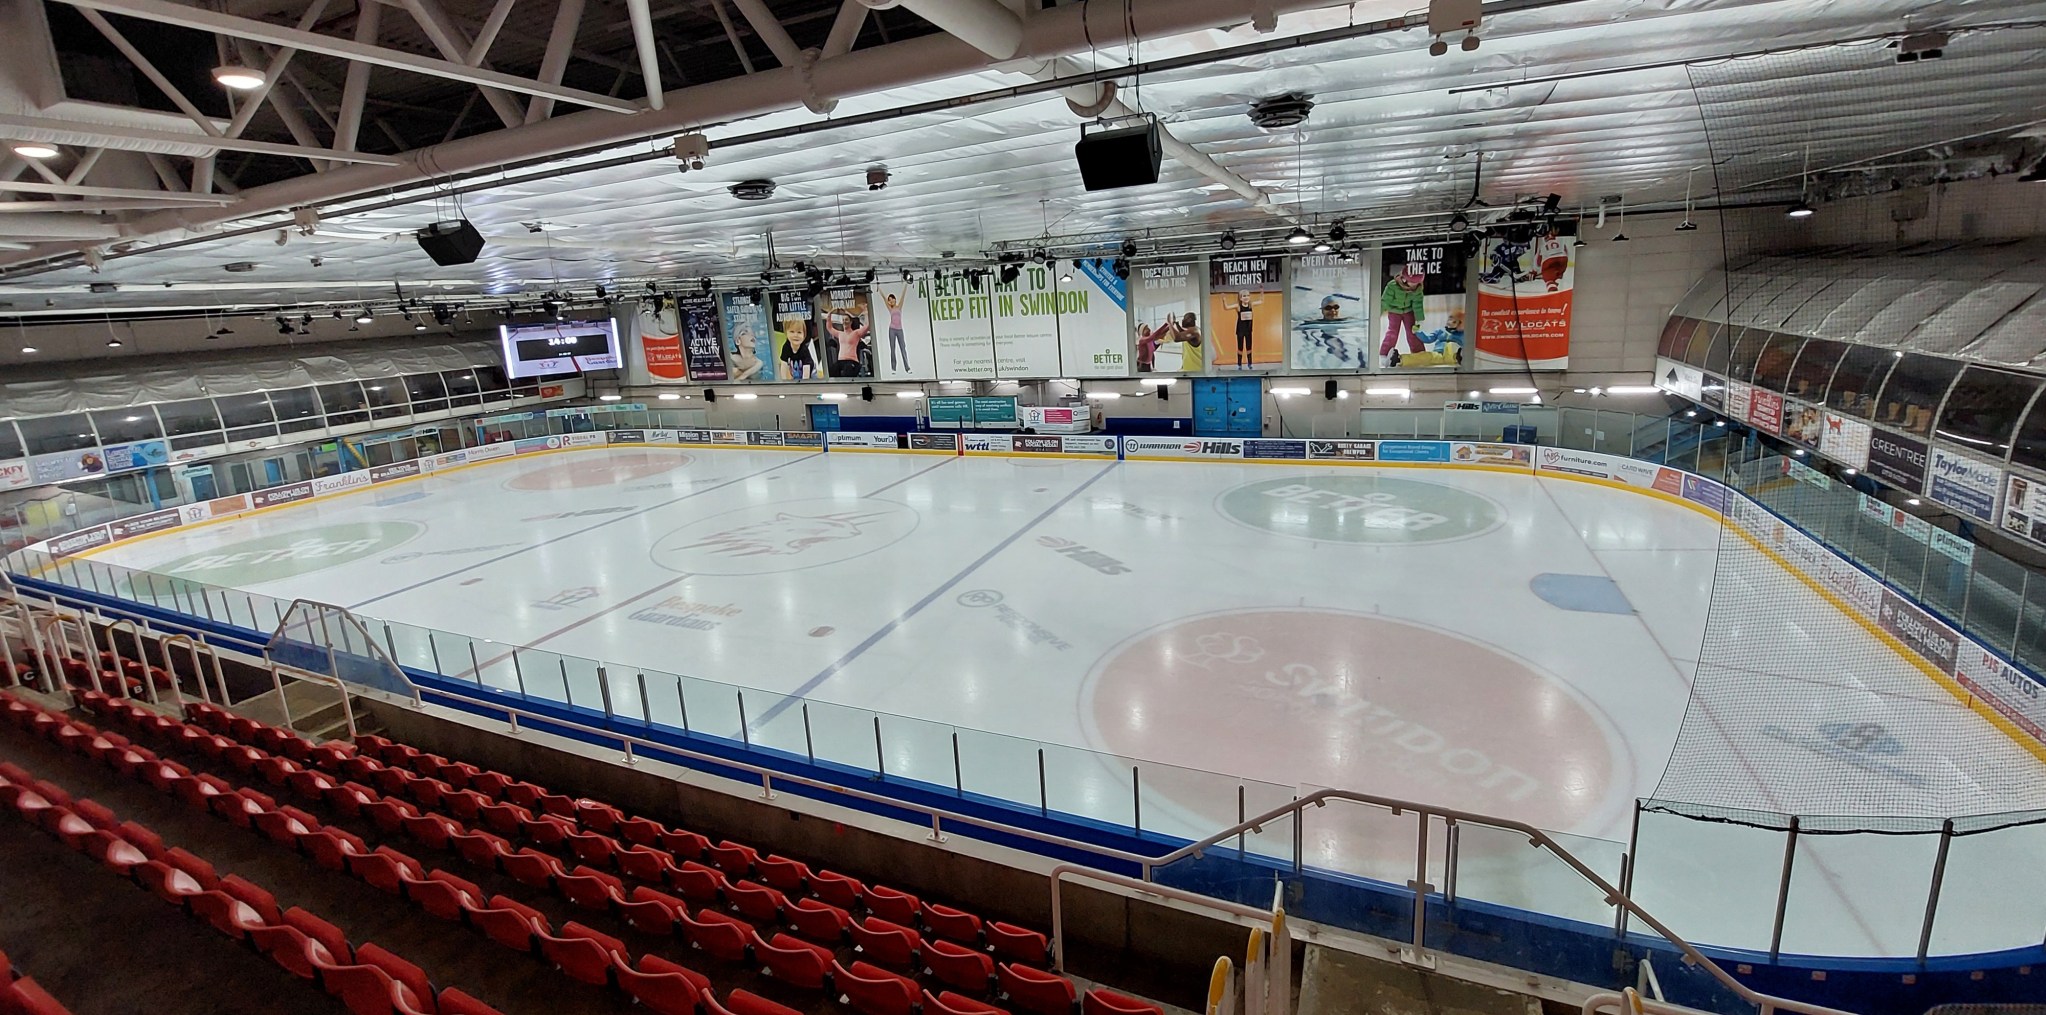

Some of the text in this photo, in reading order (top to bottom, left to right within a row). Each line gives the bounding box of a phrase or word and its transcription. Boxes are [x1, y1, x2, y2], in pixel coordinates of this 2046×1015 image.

[1406, 247, 1443, 261] TAKE TO
[1223, 259, 1267, 274] REACH NEW
[1301, 255, 1326, 268] EVERY
[1406, 261, 1442, 275] THE ICE
[1176, 265, 1189, 277] YOU
[1312, 267, 1348, 279] MATTERS
[918, 276, 927, 299] A
[1026, 267, 1046, 291] TO
[1144, 277, 1187, 290] CAN DO THIS
[1229, 273, 1262, 286] HEIGHTS
[789, 301, 807, 312] LITTLE
[931, 290, 1089, 321] KEEP FIT IN SWINDON
[1504, 320, 1567, 328] WLDCATS
[690, 337, 718, 347] ACTIVE
[689, 346, 720, 355] REALITY
[1093, 354, 1123, 364] BETTER
[965, 442, 989, 451] wttl
[1201, 441, 1241, 454] Hills
[1871, 437, 1926, 468] GREENTREE
[1560, 454, 1607, 467] furniture.com
[315, 473, 369, 493] Franklin's
[1261, 484, 1449, 531] BETTER
[1055, 545, 1132, 576] Hills
[655, 595, 743, 618] Bespoke
[627, 606, 722, 631] Guardians
[23, 671, 35, 681] C
[2000, 665, 2039, 699] AUTOS
[133, 685, 143, 694] B
